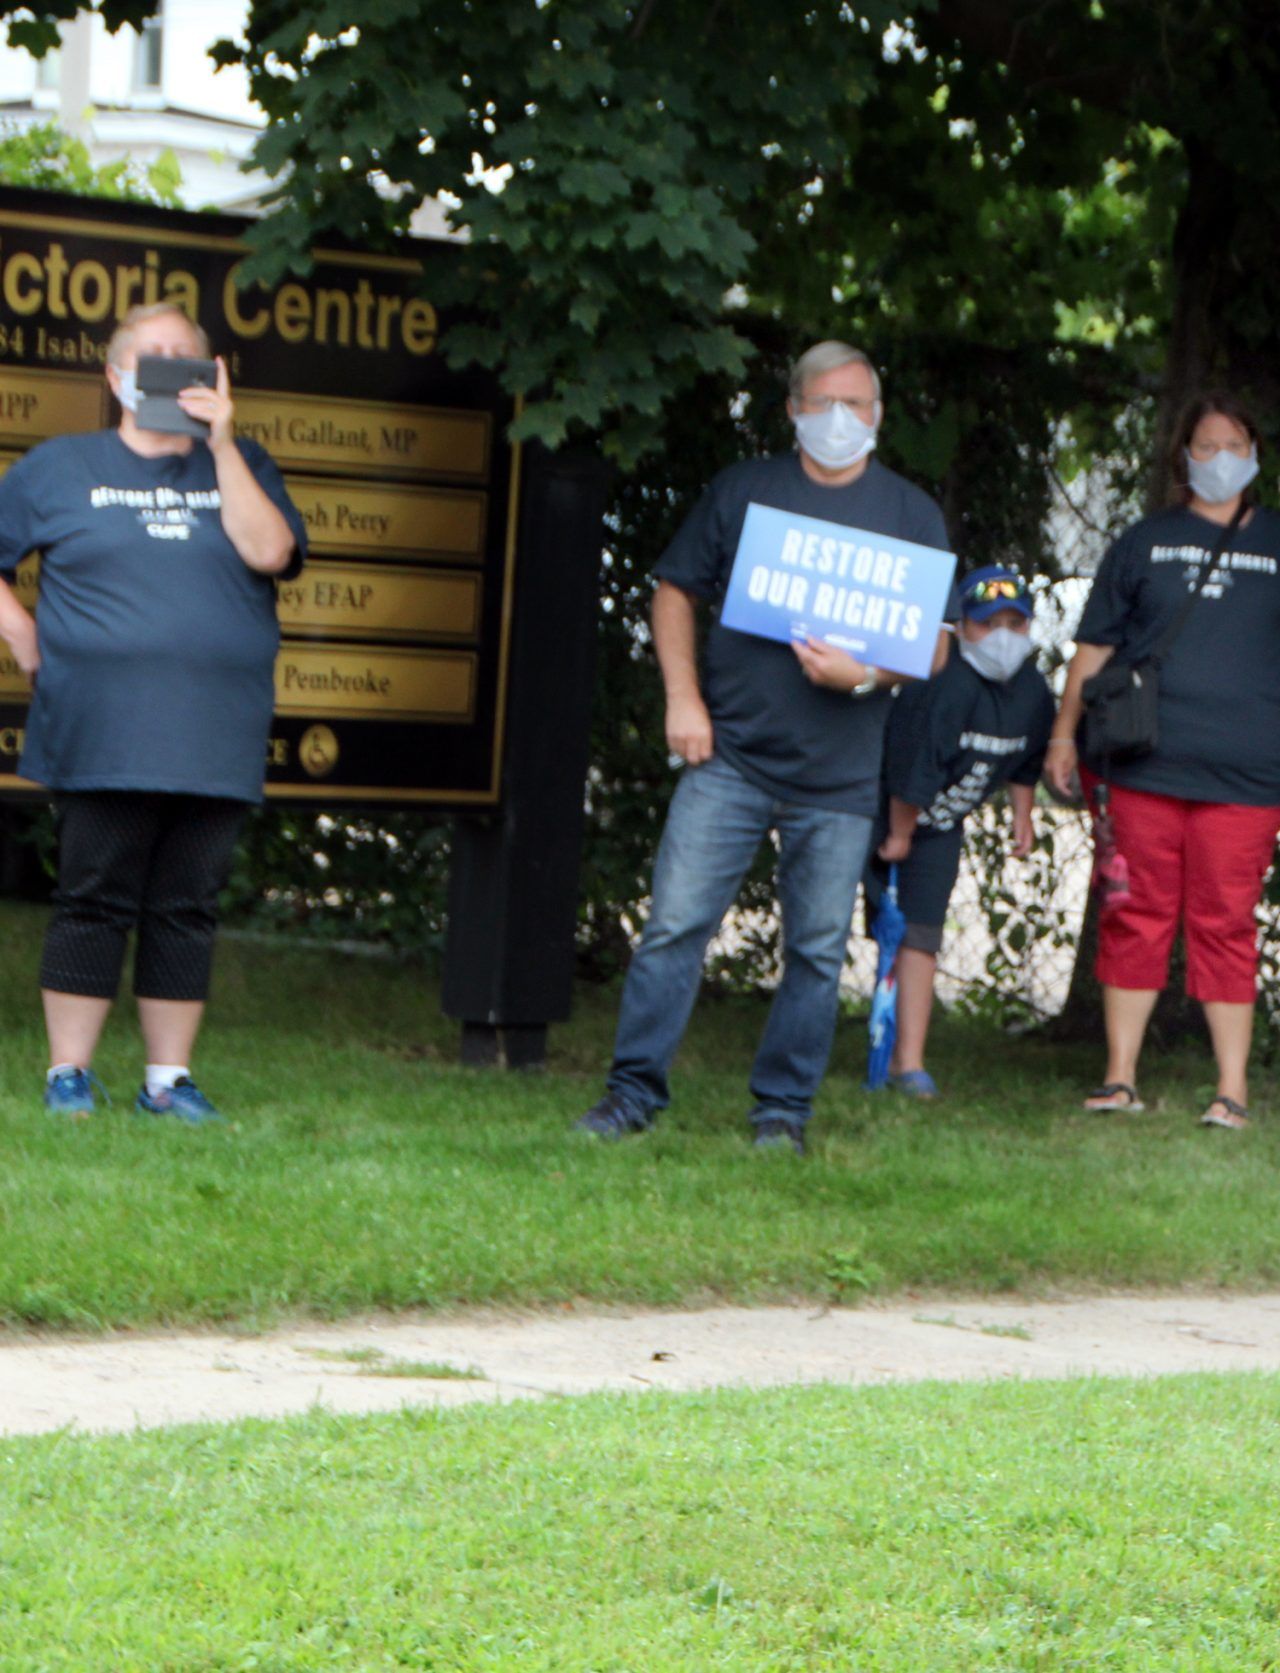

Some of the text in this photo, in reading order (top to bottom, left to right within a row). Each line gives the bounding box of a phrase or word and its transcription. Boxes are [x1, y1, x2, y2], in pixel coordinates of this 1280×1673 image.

[2, 243, 440, 356] ctoria Centre
[37, 326, 108, 363] Isabe
[234, 416, 282, 442] eryl
[379, 425, 418, 453] MP
[781, 527, 912, 593] RESTORE
[748, 565, 809, 612] OUR
[812, 582, 923, 642] RIGHTS
[283, 662, 392, 694] Pembroke
